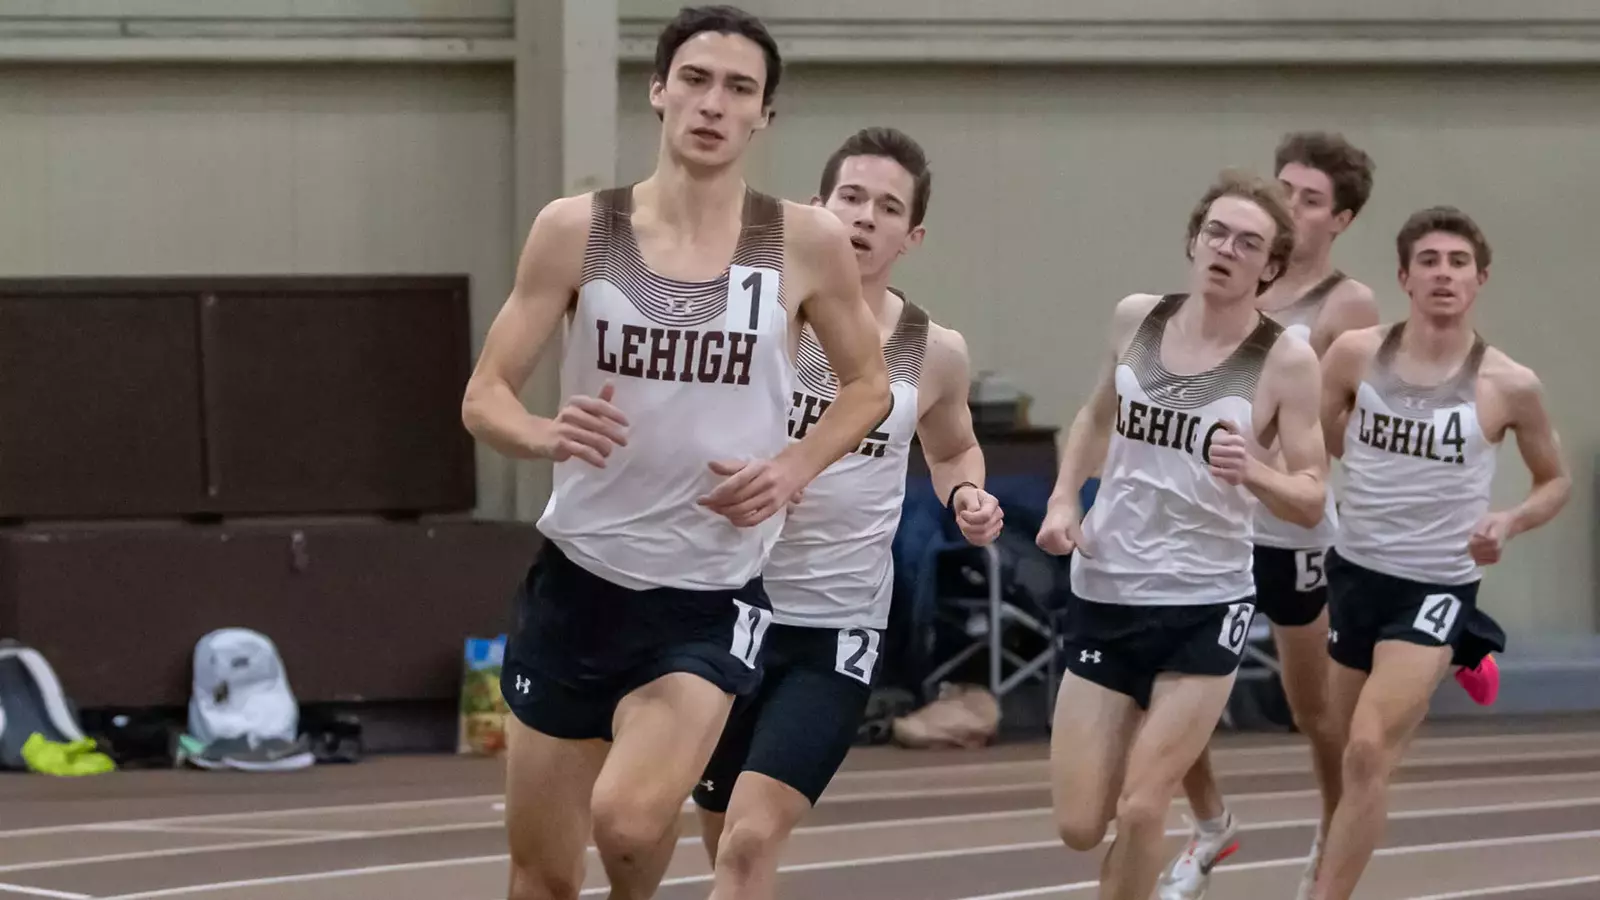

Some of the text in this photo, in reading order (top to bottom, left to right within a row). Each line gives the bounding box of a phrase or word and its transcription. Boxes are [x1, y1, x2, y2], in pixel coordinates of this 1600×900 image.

[741, 271, 763, 331] 1
[596, 319, 758, 386] LEHIGH
[1359, 408, 1465, 464] LEHI
[1442, 411, 1466, 453] 4
[1304, 551, 1323, 589] 5
[745, 607, 761, 661] 1
[1229, 604, 1250, 648] 6
[1424, 597, 1453, 634] 4
[844, 628, 870, 678] 2
